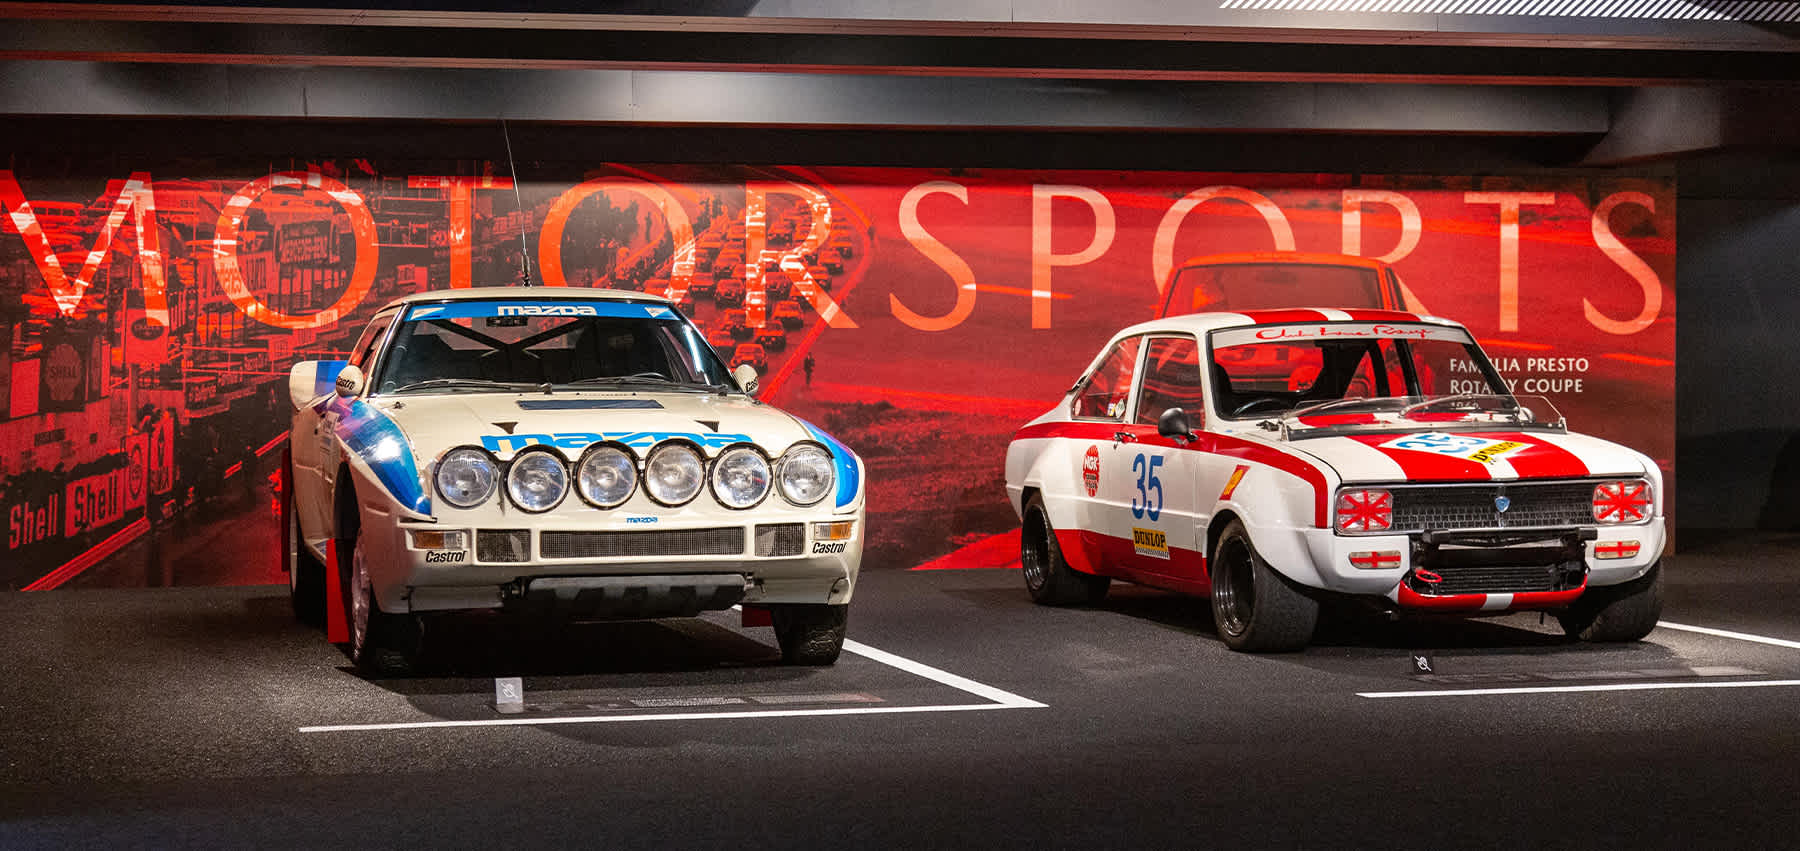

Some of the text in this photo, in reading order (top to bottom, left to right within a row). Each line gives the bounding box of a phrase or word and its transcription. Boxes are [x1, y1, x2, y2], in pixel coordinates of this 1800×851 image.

[0, 172, 1663, 335] MOTORSPORTS
[1450, 358, 1589, 373] FAMLIA PRESTO
[1450, 378, 1583, 394] ROTAY COUPE
[1083, 455, 1099, 471] NGK
[1131, 453, 1164, 522] 35
[9, 492, 58, 549] Shell
[73, 471, 118, 529] Shell
[812, 541, 847, 554] Castrol
[1133, 530, 1168, 549] DUNLOP
[425, 550, 468, 563] Castrol
